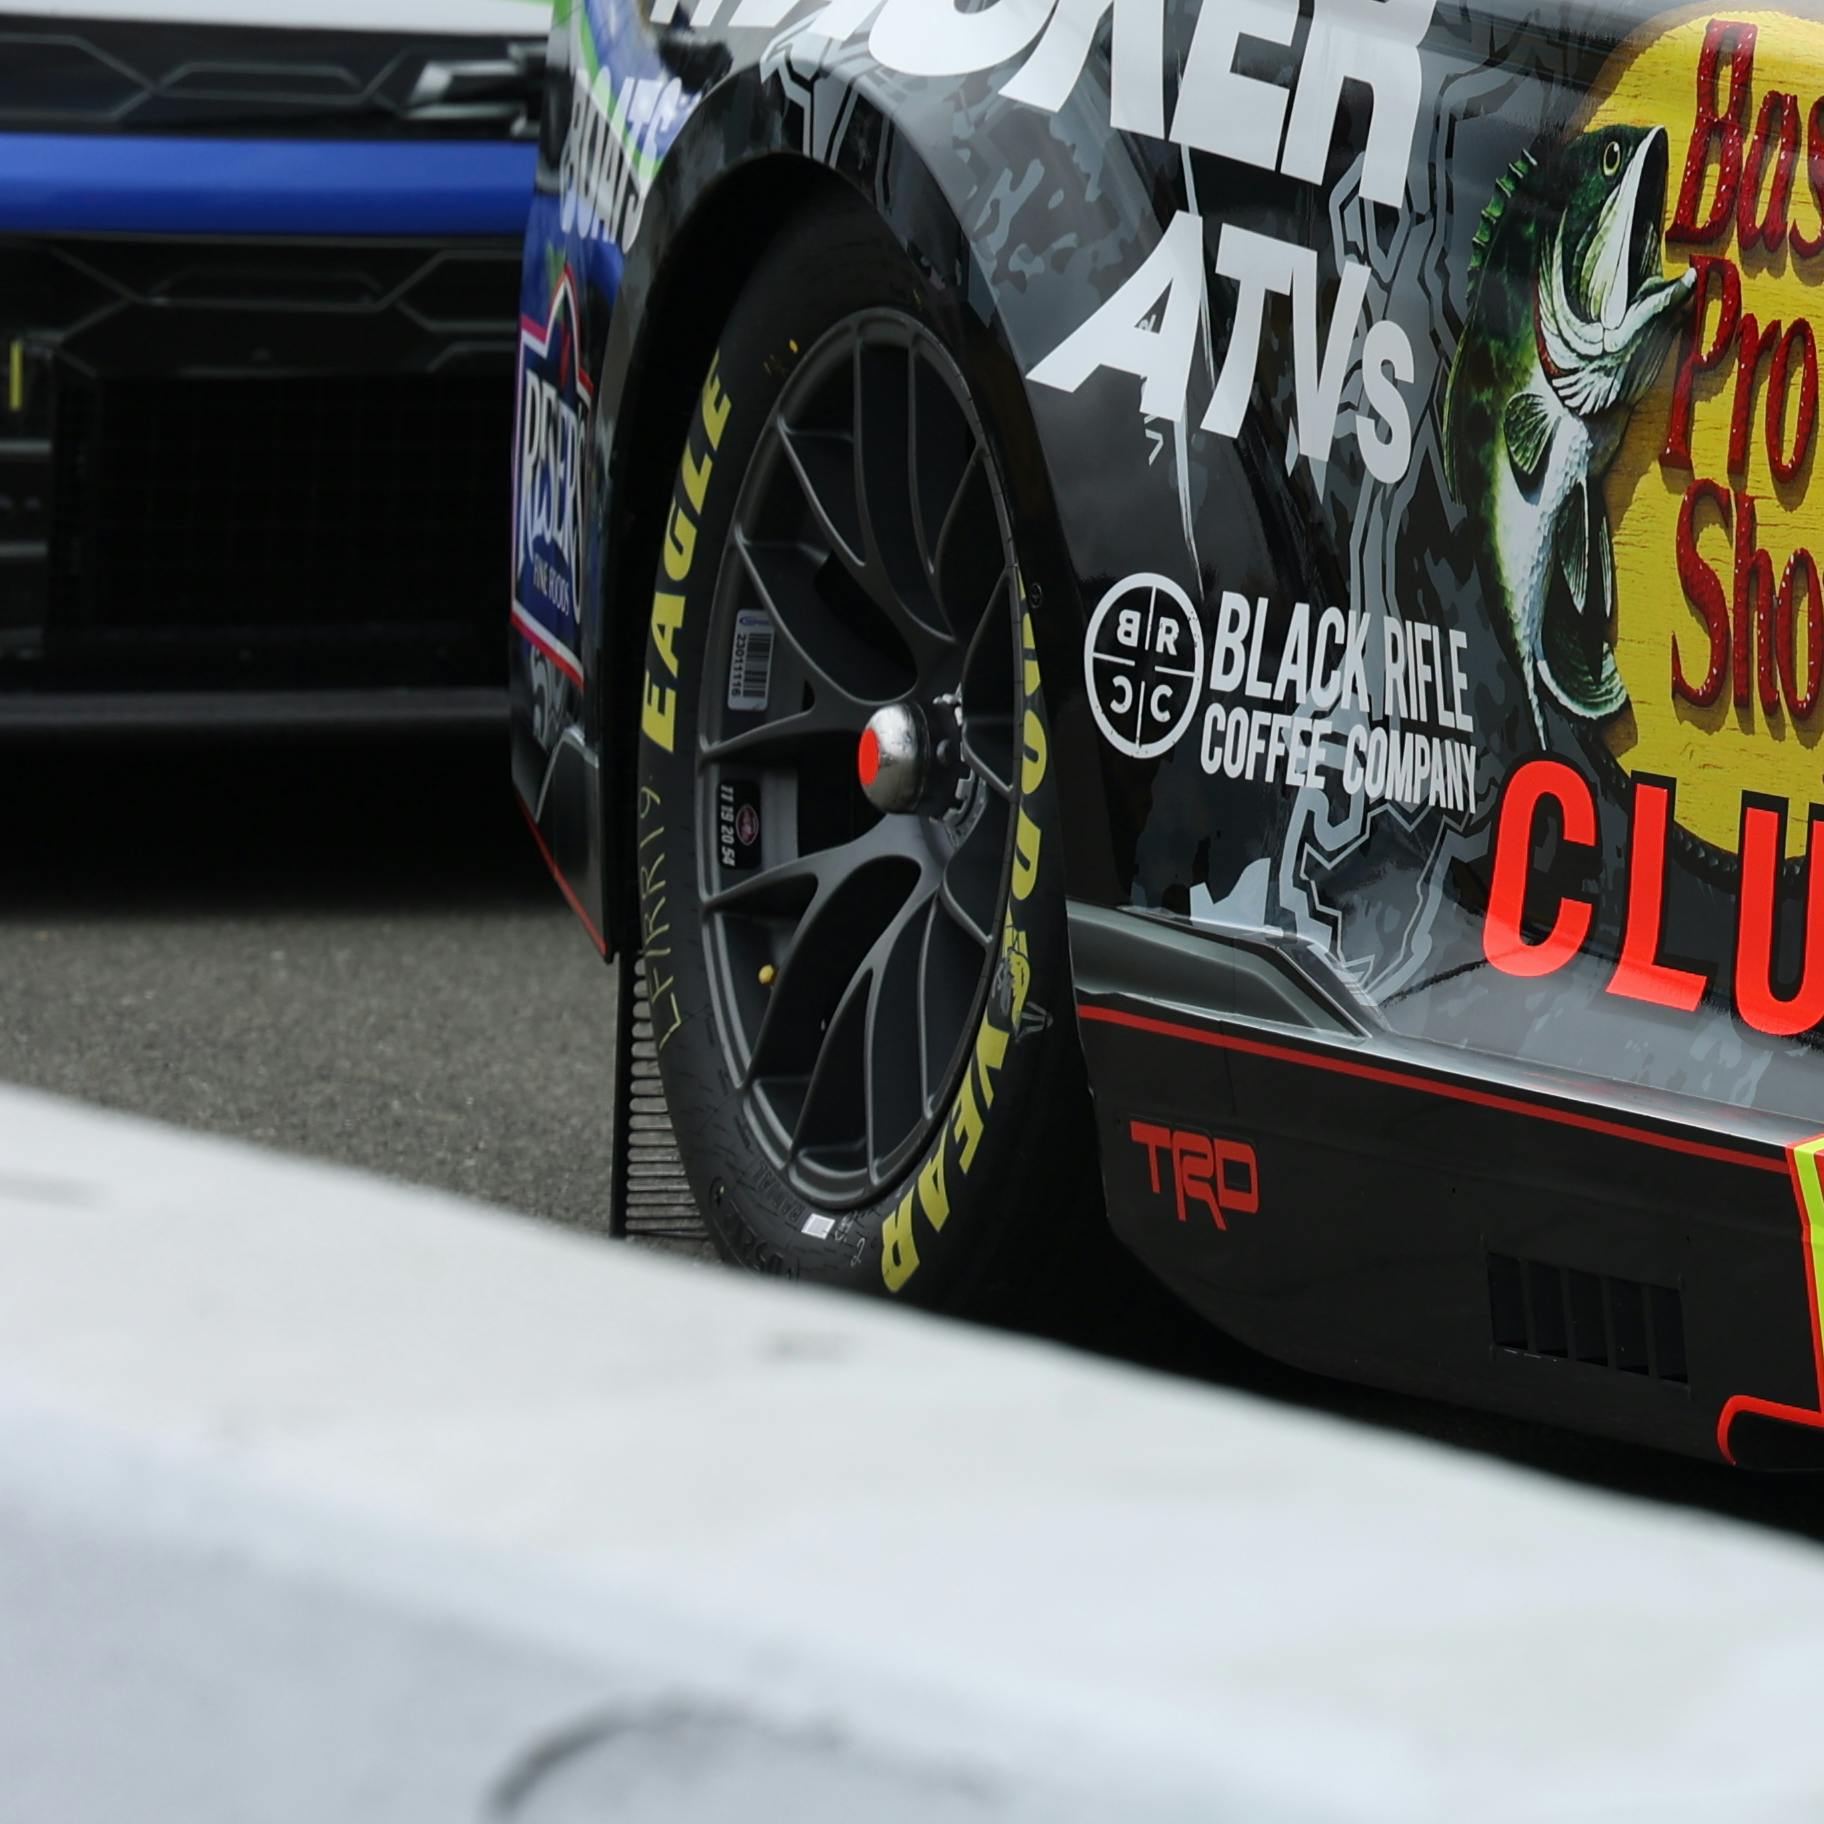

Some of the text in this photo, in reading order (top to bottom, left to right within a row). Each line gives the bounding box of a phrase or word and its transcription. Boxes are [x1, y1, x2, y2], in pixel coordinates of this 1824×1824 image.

[1027, 210, 1412, 486] ATVs
[1658, 254, 1819, 484] Pro
[640, 346, 732, 753] EAGLE
[1209, 592, 1473, 732] BLACK RIFLE
[1201, 702, 1476, 814] COFFEE COMPANY
[1130, 1120, 1258, 1230] TRD
